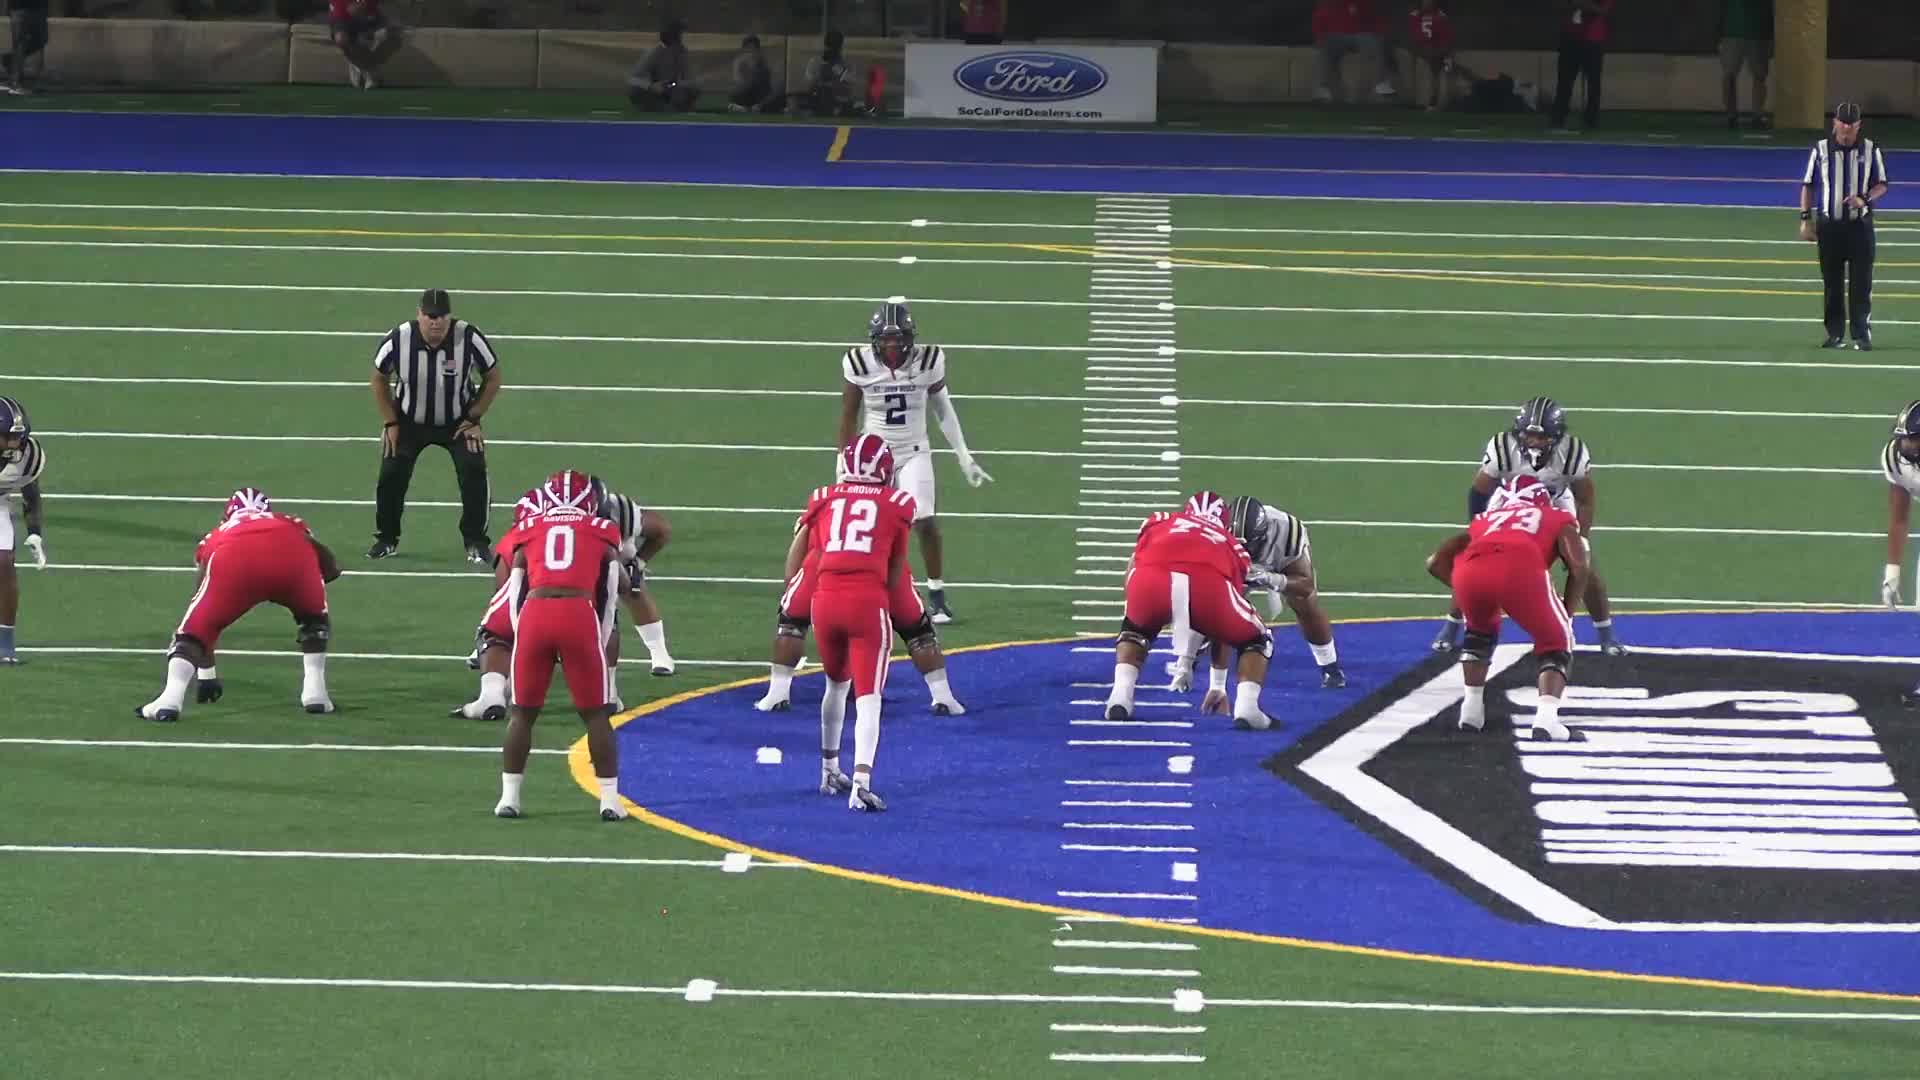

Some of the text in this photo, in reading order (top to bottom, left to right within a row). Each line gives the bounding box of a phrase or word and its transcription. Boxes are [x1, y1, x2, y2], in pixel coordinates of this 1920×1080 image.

[984, 58, 1077, 93] Ford
[957, 107, 1103, 119] SoCalFordDealers.com
[885, 394, 907, 424] 2
[825, 498, 878, 553] 12
[1483, 507, 1542, 536] 73
[544, 525, 575, 570] 0
